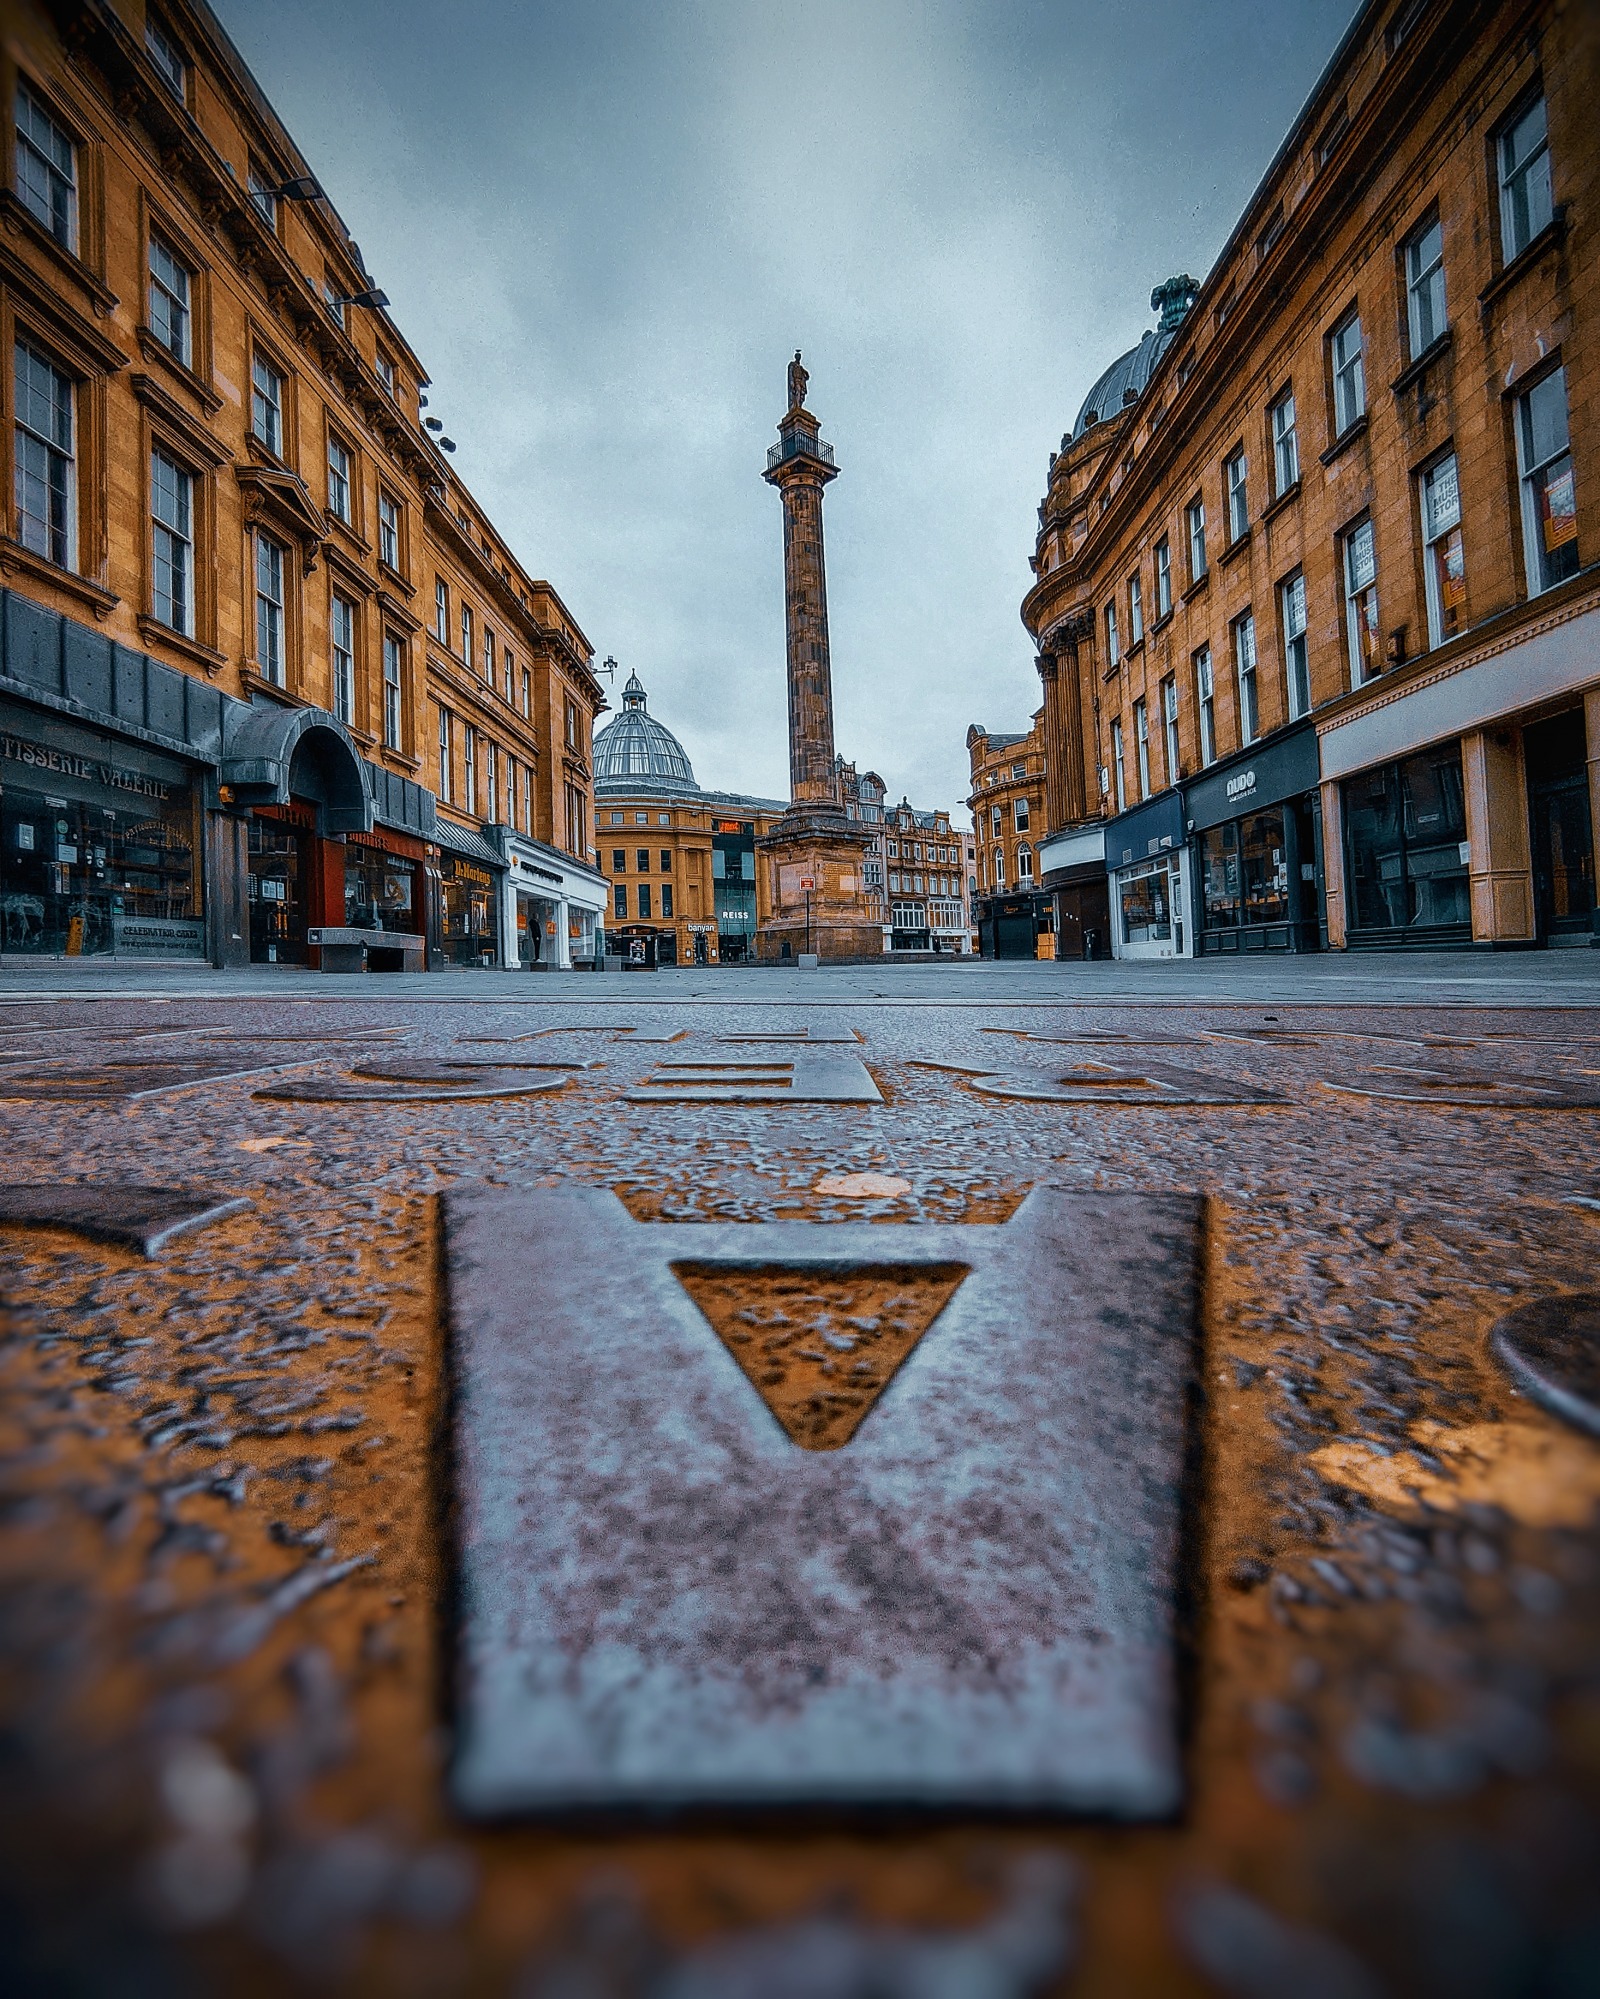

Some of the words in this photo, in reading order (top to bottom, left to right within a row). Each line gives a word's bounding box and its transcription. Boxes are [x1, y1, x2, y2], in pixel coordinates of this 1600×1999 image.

[1439, 473, 1458, 493] THE
[1433, 484, 1457, 508] MUSI
[1434, 494, 1458, 519] STOR
[1, 738, 91, 780] TISSERIE
[722, 911, 749, 920] REISS
[688, 923, 715, 933] banyan
[0, 1057, 1600, 1110] PRESE
